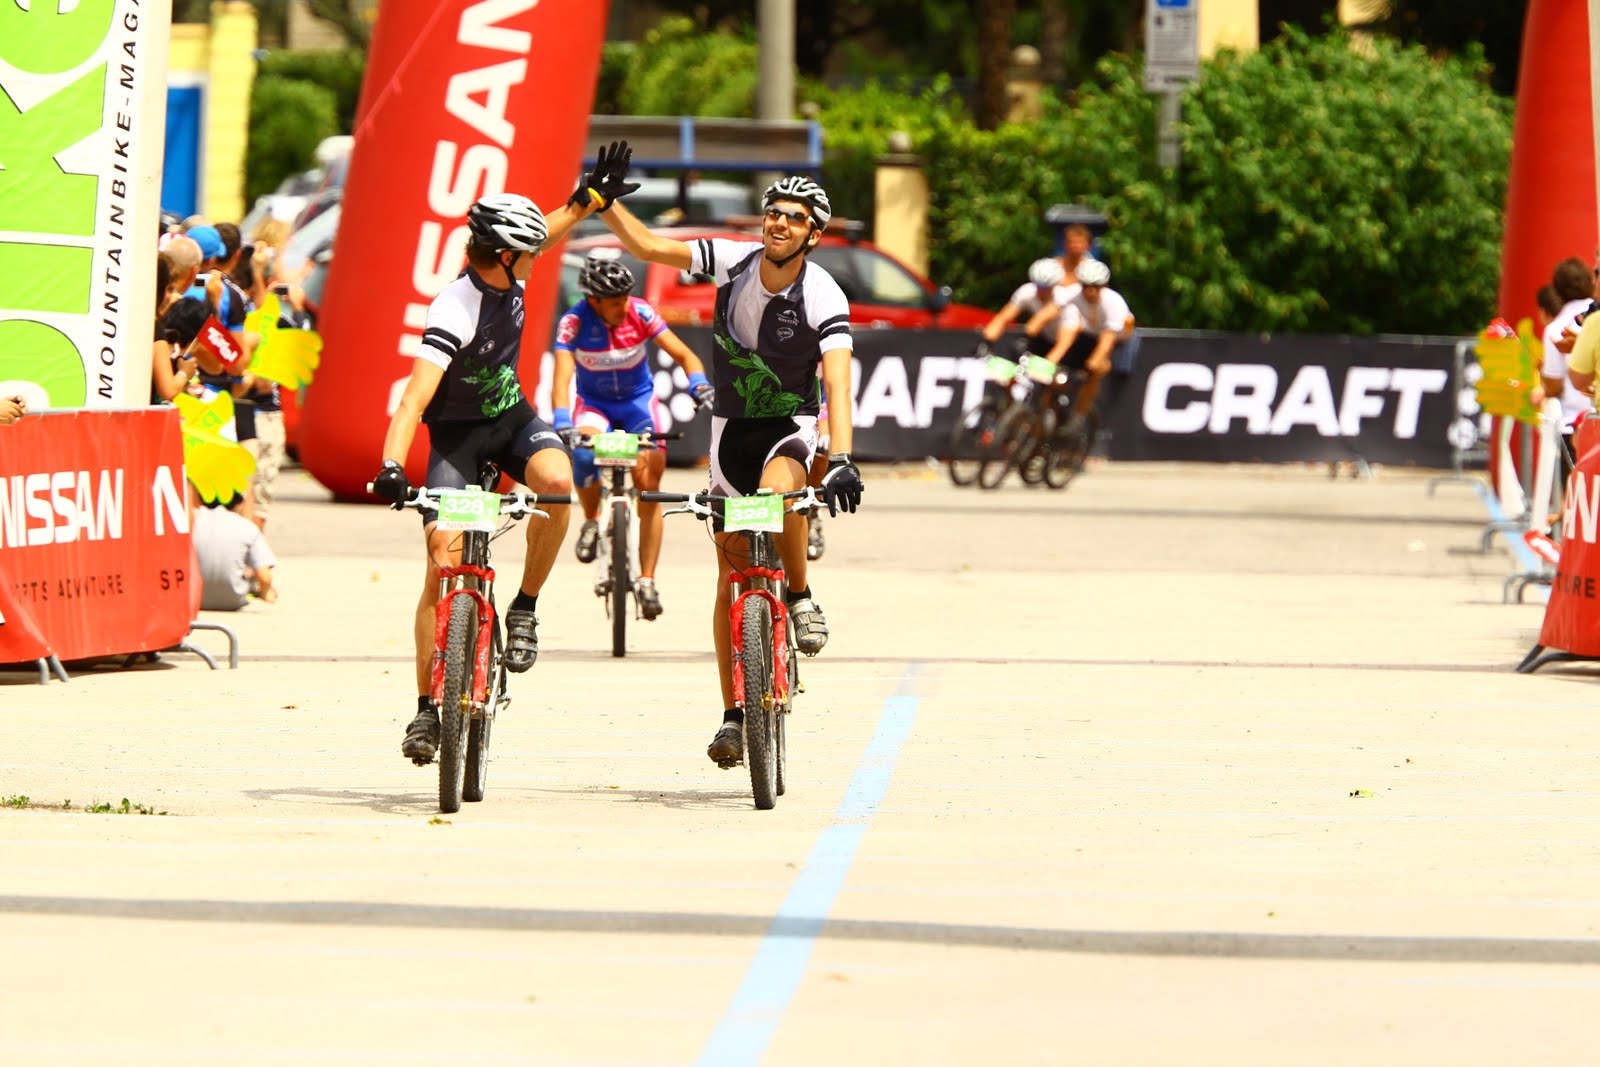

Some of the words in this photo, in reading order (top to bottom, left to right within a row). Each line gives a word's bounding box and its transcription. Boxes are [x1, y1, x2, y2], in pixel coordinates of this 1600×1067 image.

[386, 0, 540, 418] SSAN
[851, 356, 990, 429] AFT
[1142, 361, 1448, 439] CRAFT
[0, 468, 124, 549] NISSAN
[444, 498, 484, 515] 328
[730, 507, 769, 521] 328
